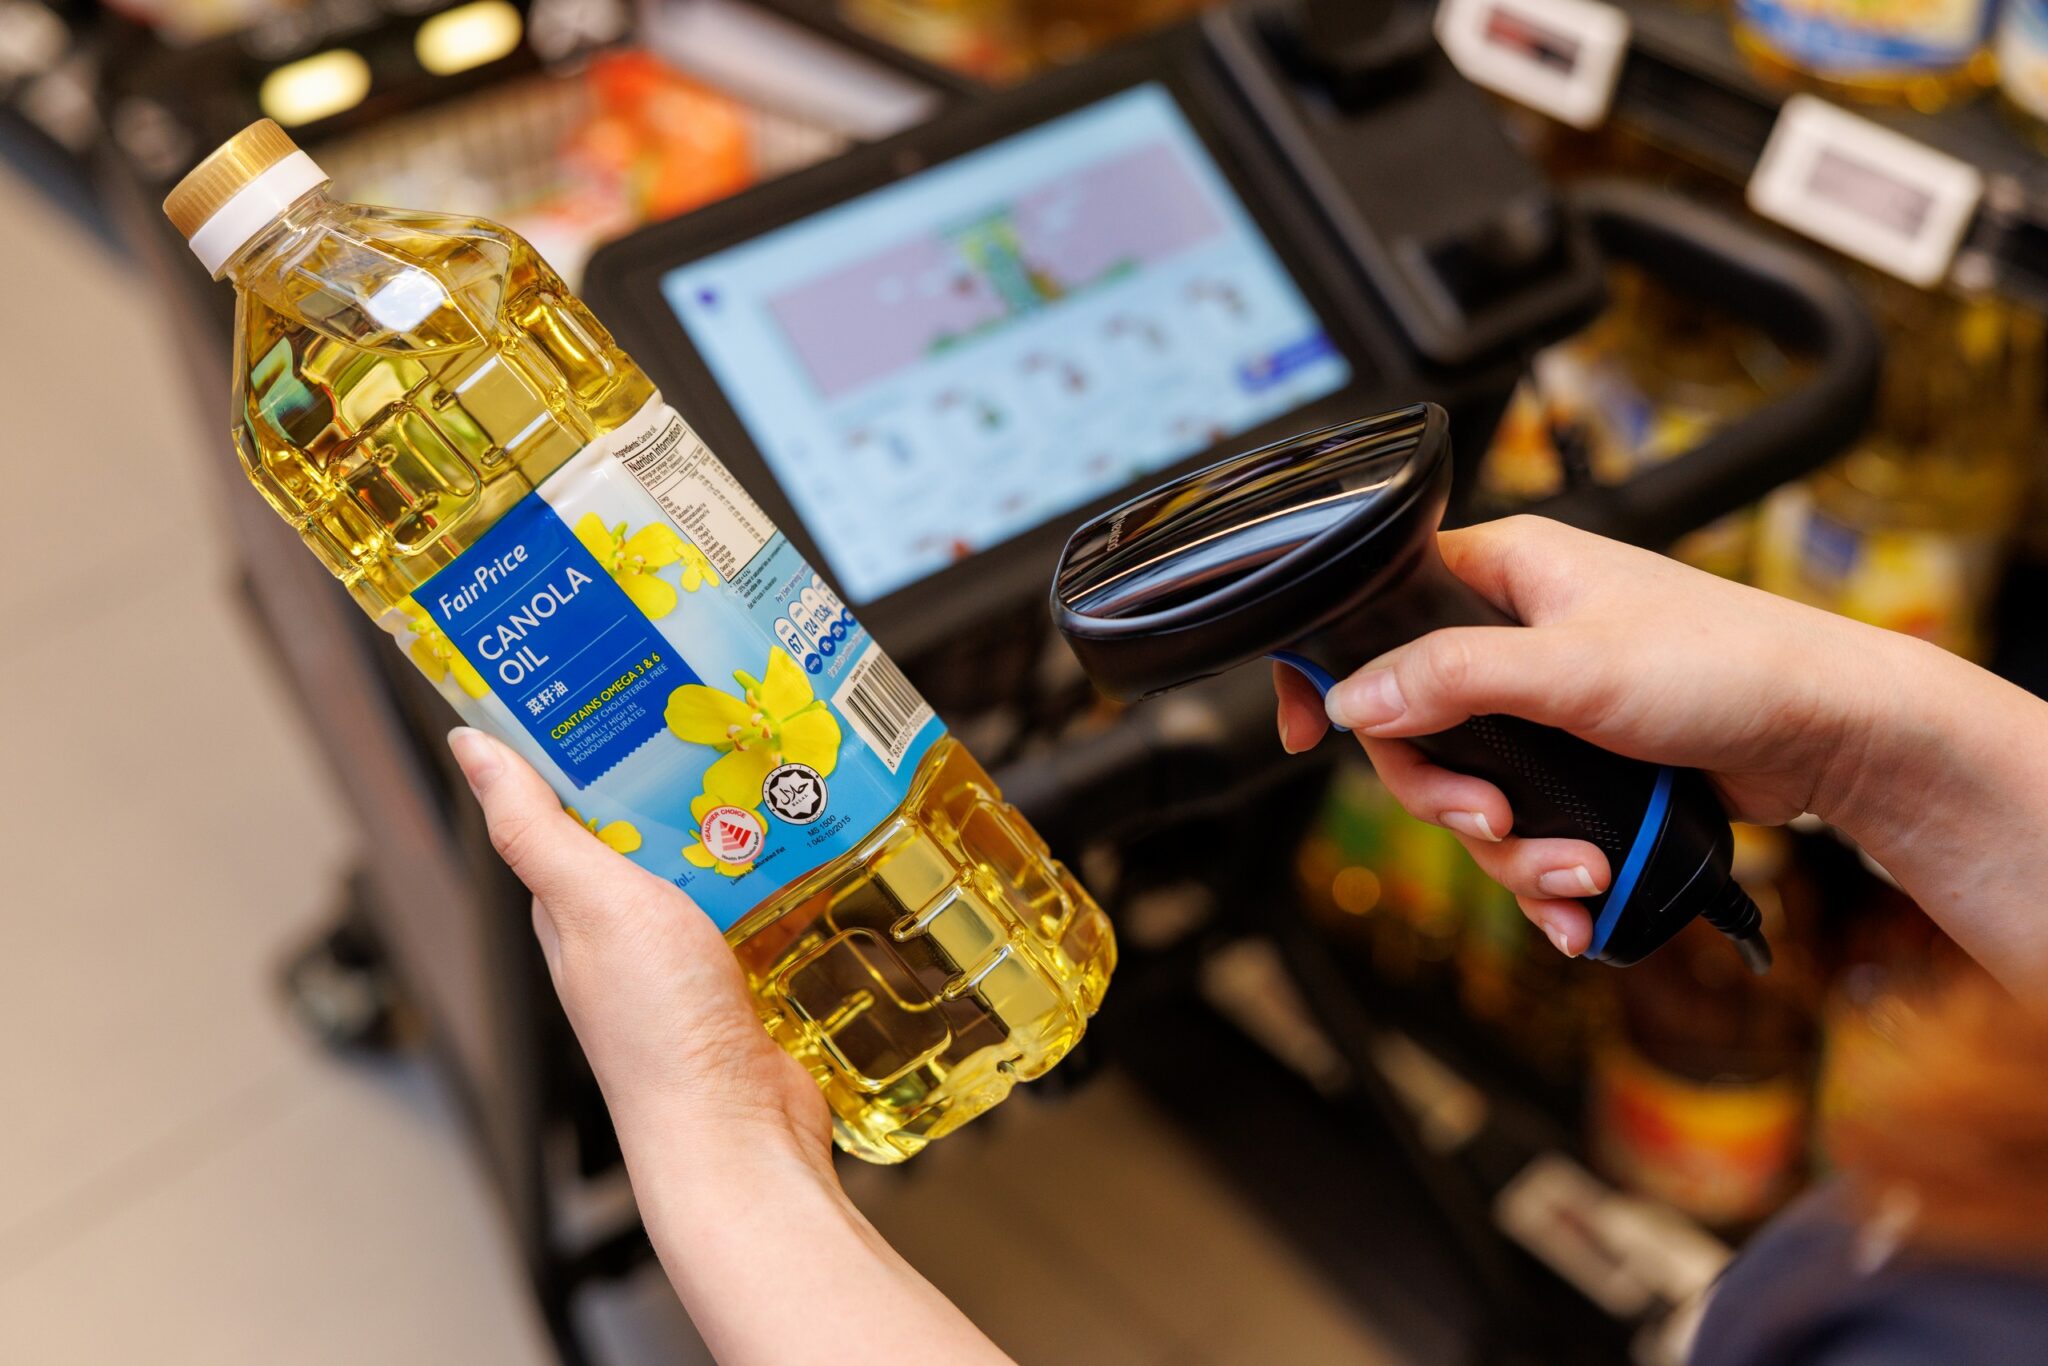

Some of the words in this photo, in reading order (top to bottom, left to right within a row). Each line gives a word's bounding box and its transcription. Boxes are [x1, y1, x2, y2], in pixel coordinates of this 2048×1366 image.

[628, 451, 657, 472] Nutrition
[652, 423, 684, 457] Information
[438, 544, 529, 620] FairPrice
[477, 567, 593, 660] CANOLA
[787, 632, 804, 654] 67
[804, 618, 818, 637] 124
[499, 645, 550, 685] OIL
[525, 680, 569, 717] 菜籽油
[551, 698, 602, 740] CONTAINS
[600, 670, 639, 701] OMEGA
[635, 664, 645, 675] 3
[642, 659, 653, 669] &
[651, 652, 661, 663] 6
[559, 714, 600, 749] NATURALLY
[600, 678, 651, 718] CHOLESTEROL
[649, 663, 669, 680] FREE
[566, 722, 609, 759] NATURALLY
[609, 708, 628, 727] HIGH
[627, 702, 638, 715] IN
[572, 707, 647, 765] MONOUNSATURATES
[779, 782, 809, 805] حلال
[705, 811, 720, 842] HEALTHIER
[720, 809, 747, 819] CHOICE
[820, 814, 837, 829] 1500
